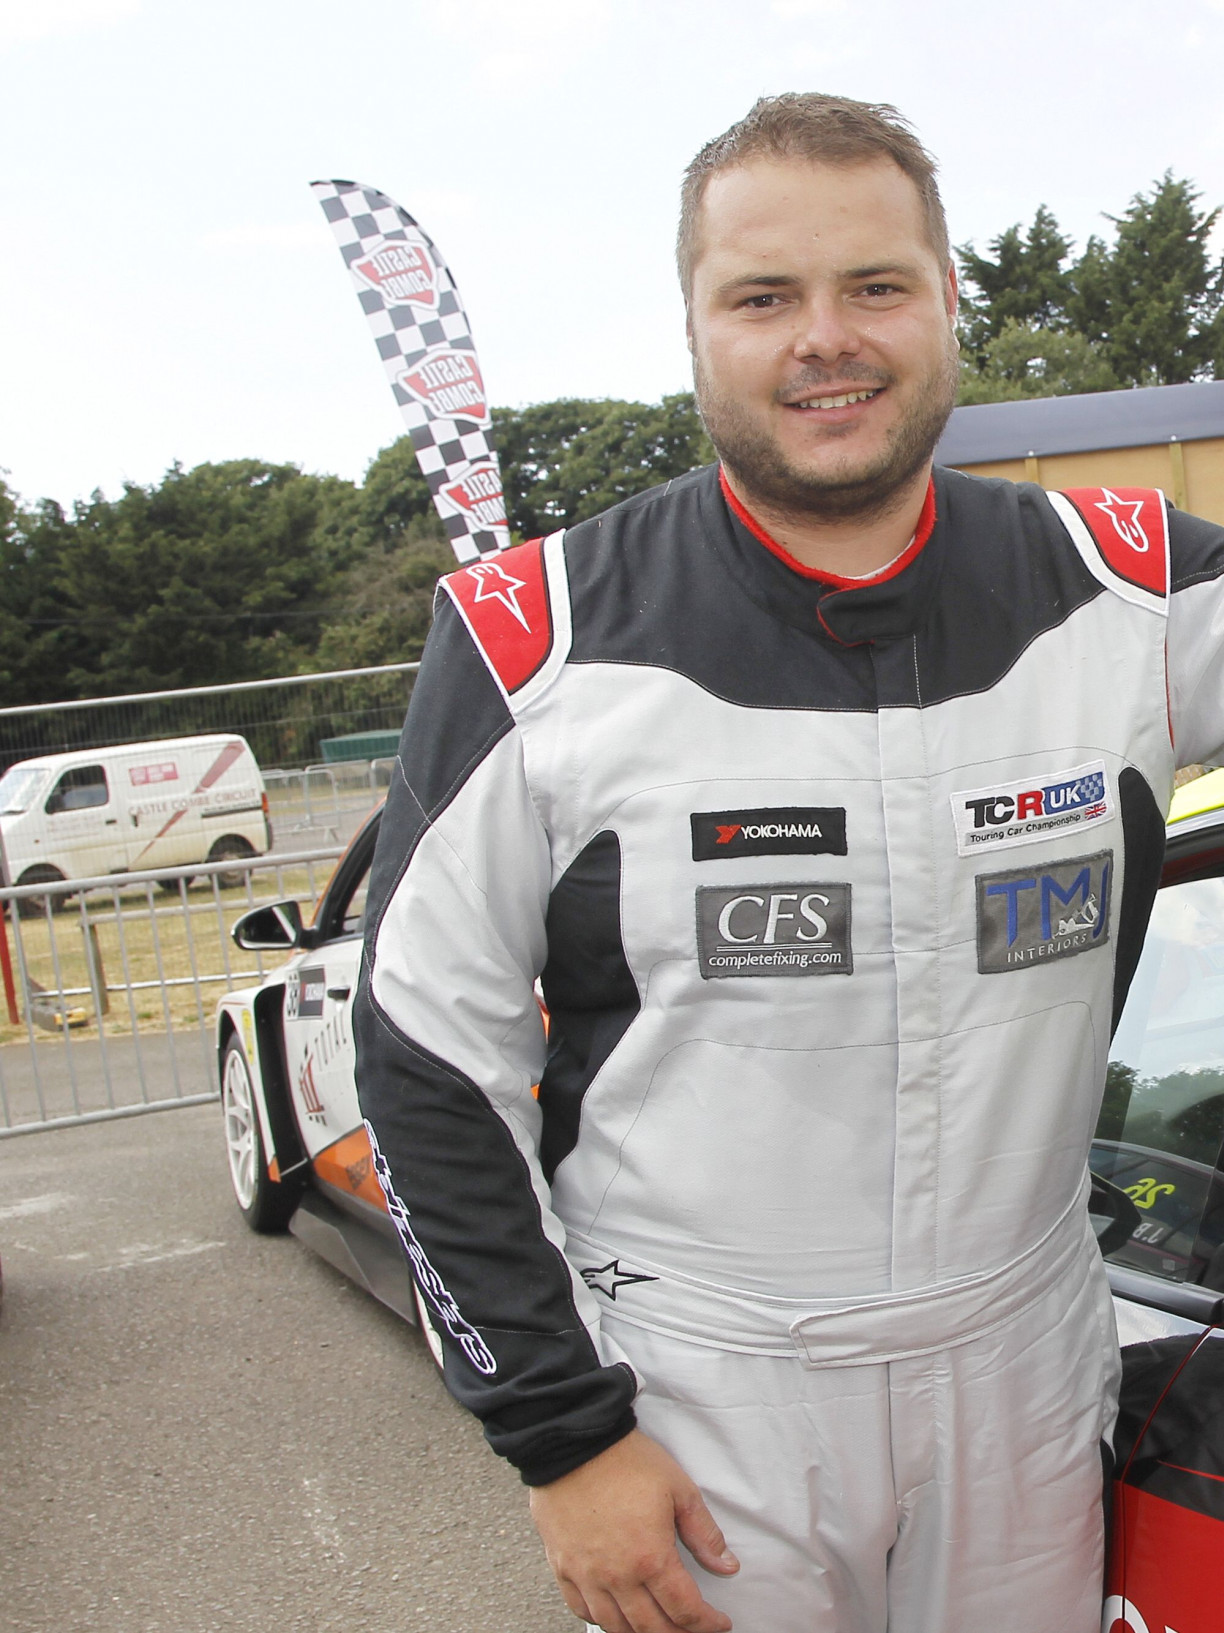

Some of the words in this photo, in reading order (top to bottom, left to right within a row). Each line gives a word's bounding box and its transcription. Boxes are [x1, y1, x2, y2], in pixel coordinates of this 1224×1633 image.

[128, 803, 167, 817] CASTLE
[171, 796, 211, 811] COMBE
[740, 823, 823, 841] YOKOHAMA
[970, 829, 1005, 845] Touring
[1007, 825, 1024, 838] Car
[1025, 813, 1082, 835] Championship
[717, 892, 832, 944] CFS
[708, 949, 843, 971] completefixing.com
[1006, 934, 1088, 964] INTERIORS
